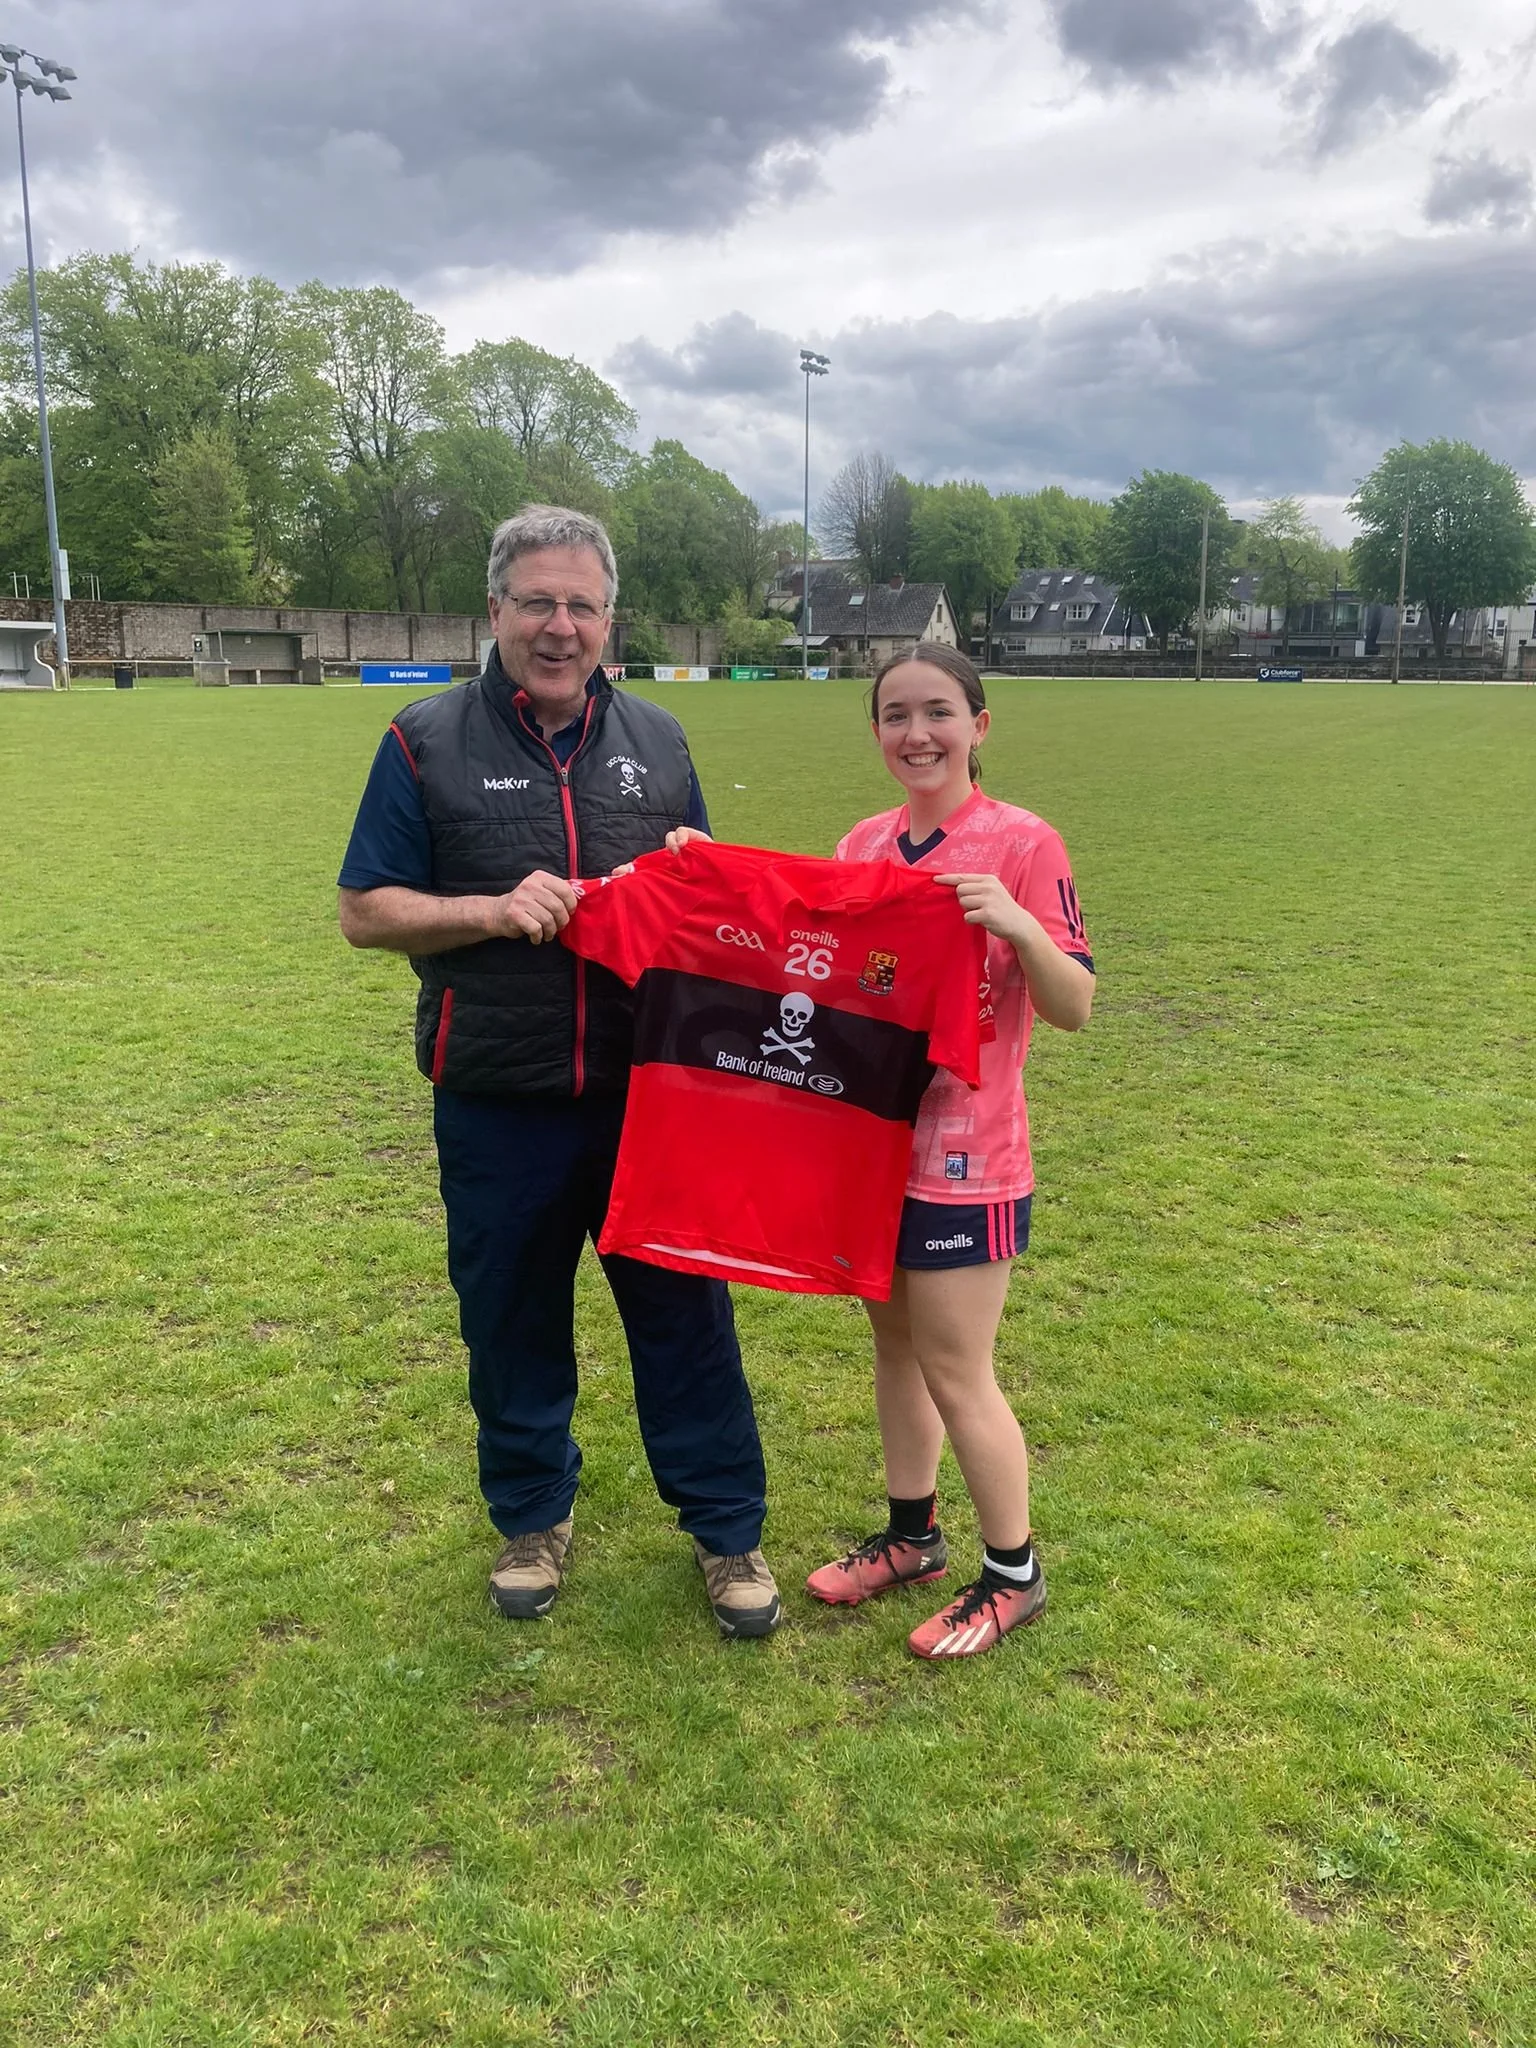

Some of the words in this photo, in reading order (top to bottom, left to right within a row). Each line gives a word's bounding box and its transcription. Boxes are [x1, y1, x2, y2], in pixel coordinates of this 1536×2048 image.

[784, 943, 834, 981] 26
[716, 1051, 749, 1072] Bank
[748, 1060, 764, 1075] of
[762, 1061, 805, 1086] Ireland
